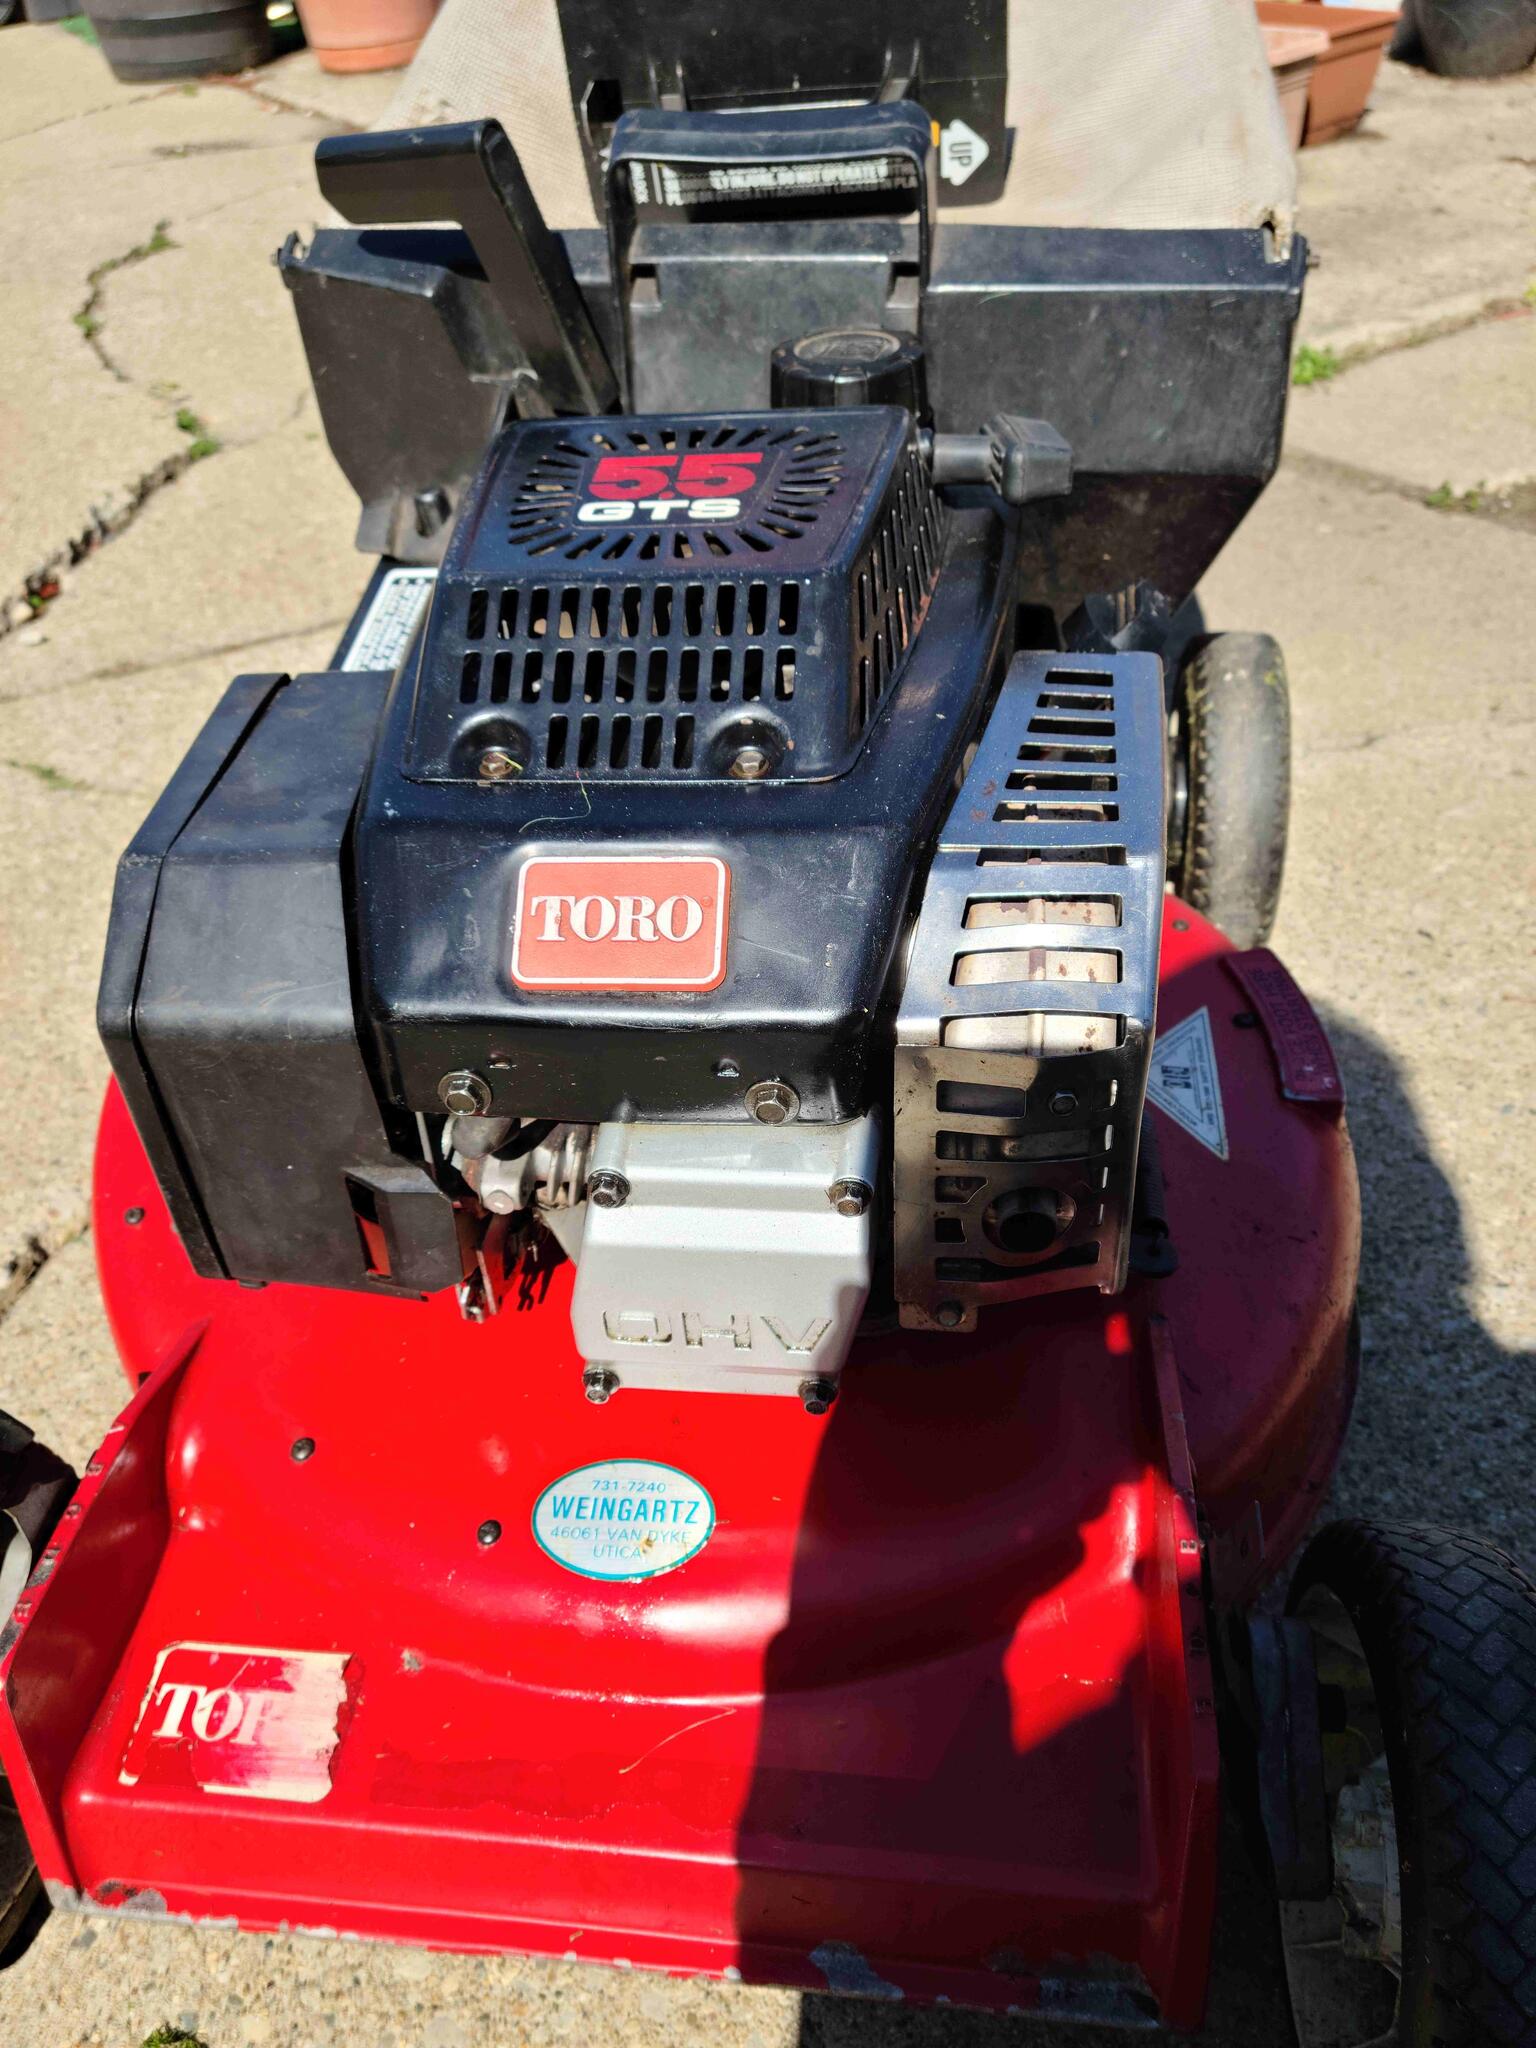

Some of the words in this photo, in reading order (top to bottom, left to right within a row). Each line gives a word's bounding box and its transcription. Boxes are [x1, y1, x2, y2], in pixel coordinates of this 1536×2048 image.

[949, 142, 972, 167] UP
[588, 452, 764, 500] 5.5
[577, 498, 741, 522] GTS
[529, 895, 704, 942] TORO
[602, 1310, 833, 1354] OHV
[591, 1479, 667, 1494] 731-7240
[551, 1495, 701, 1524] WEINGARTZ
[550, 1526, 600, 1541] 46061
[607, 1528, 643, 1542] VAN
[648, 1529, 692, 1544] DYKE
[592, 1545, 641, 1560] UTICA
